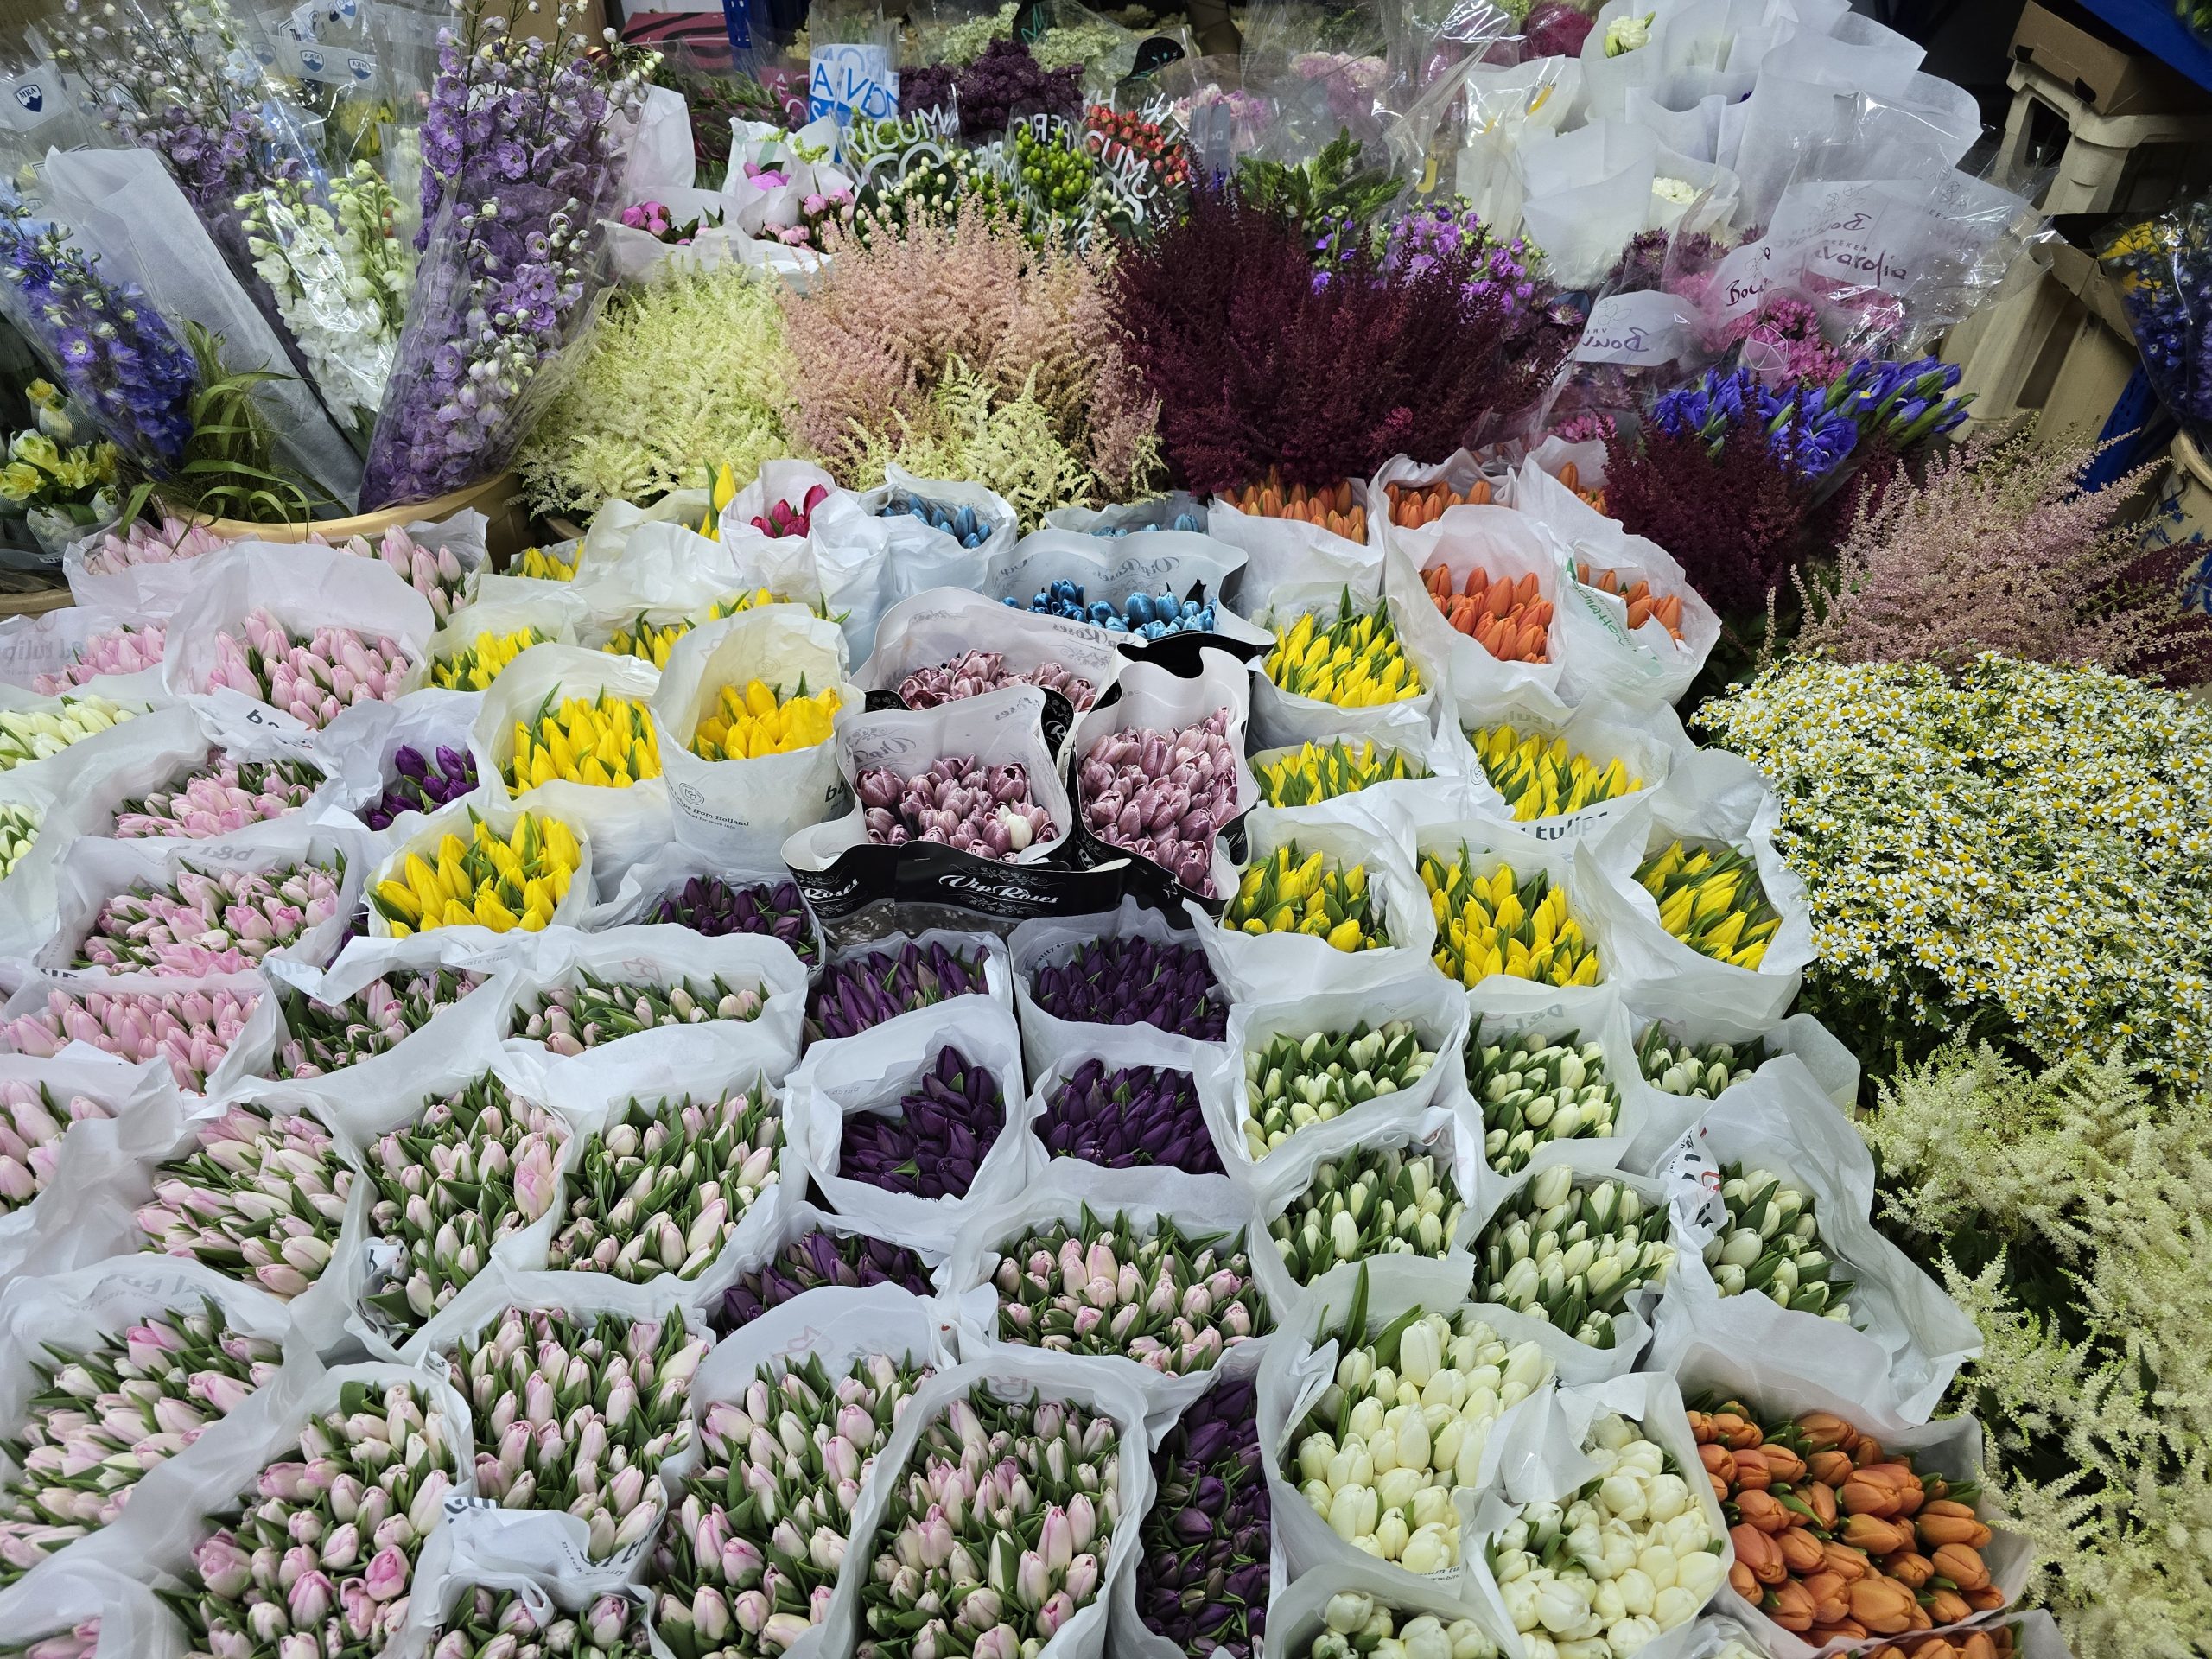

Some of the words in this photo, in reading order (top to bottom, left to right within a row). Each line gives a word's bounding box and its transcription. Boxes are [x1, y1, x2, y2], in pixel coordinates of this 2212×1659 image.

[19, 87, 37, 99] MKA
[693, 808, 714, 819] from
[715, 815, 750, 827] Holland
[938, 874, 994, 893] Vip
[992, 884, 1058, 904] Roses
[562, 1541, 582, 1573] Dutch
